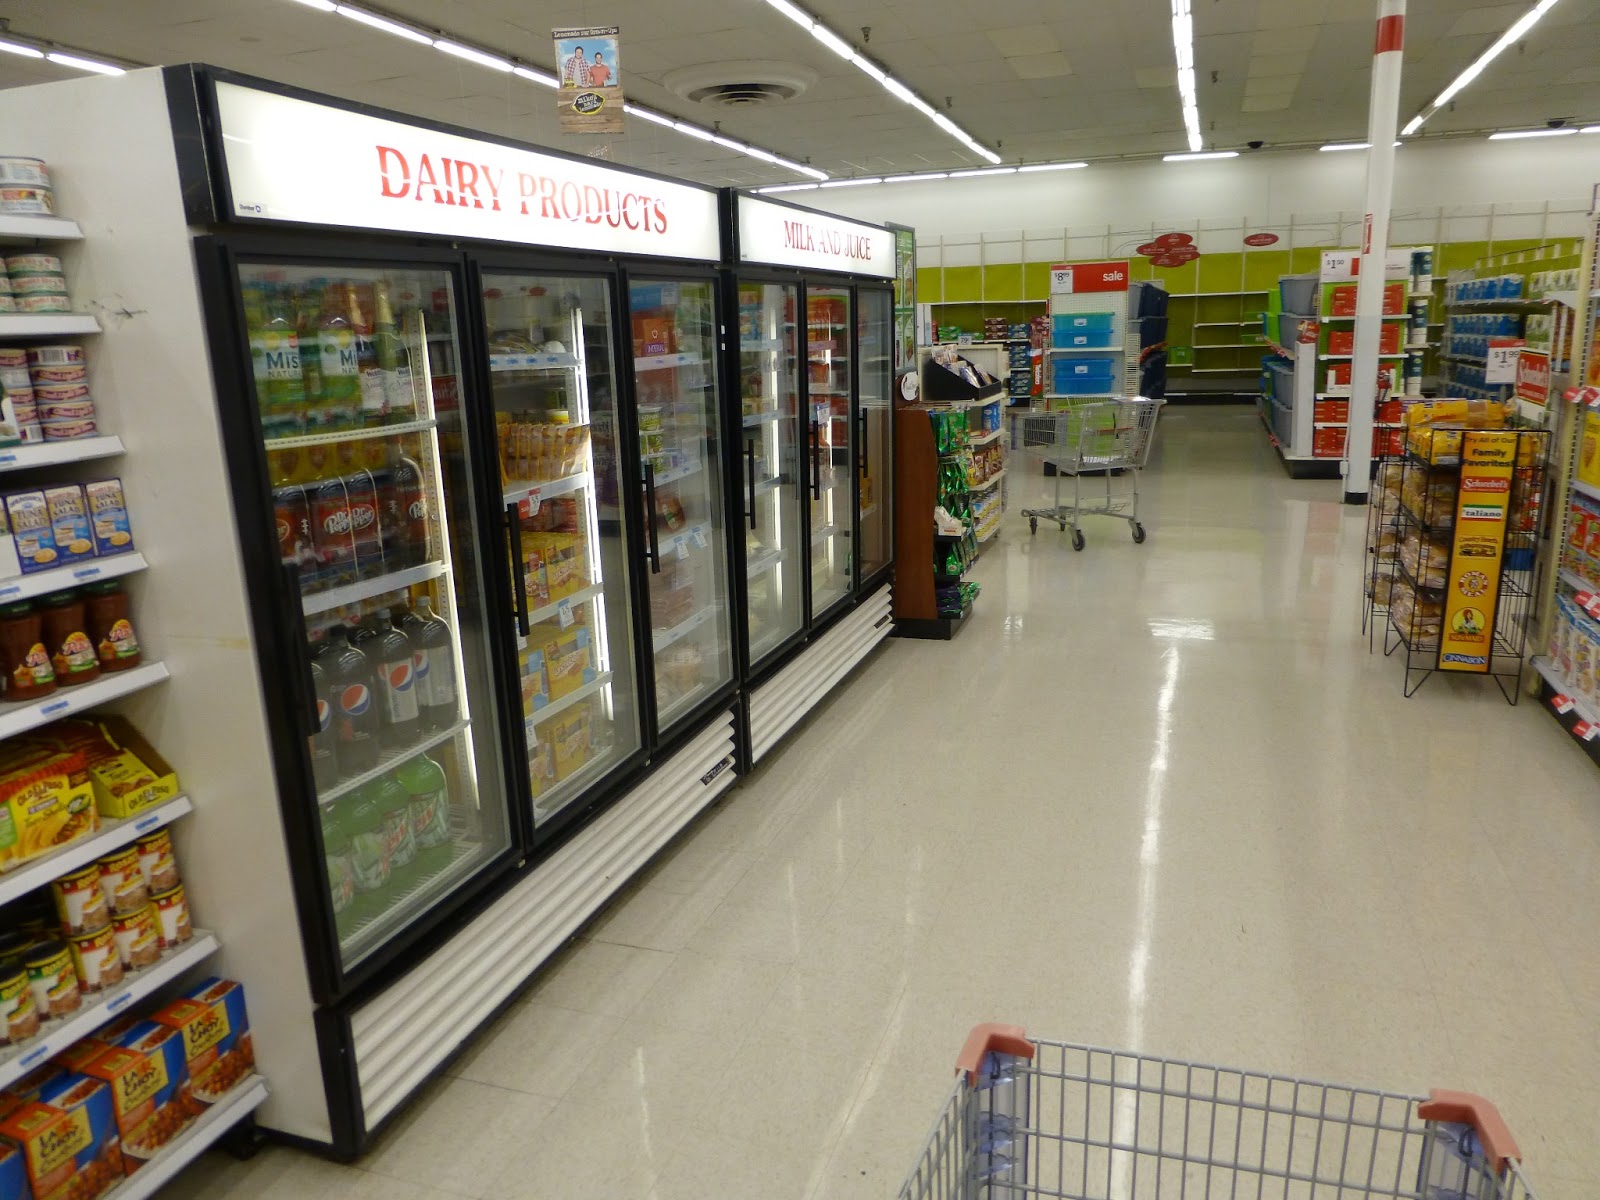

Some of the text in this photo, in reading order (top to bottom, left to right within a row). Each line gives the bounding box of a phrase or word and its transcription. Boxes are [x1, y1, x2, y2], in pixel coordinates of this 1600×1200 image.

[375, 145, 668, 234] DAIRY PRODUCTS
[783, 220, 872, 260] MILK AND JUICE
[1102, 270, 1124, 282] sale
[1472, 448, 1507, 458] Family
[188, 1020, 204, 1034] LA
[190, 1017, 219, 1045] CHOY
[122, 1070, 138, 1087] LA
[124, 1066, 157, 1098] CHOY
[39, 1130, 57, 1148] LA
